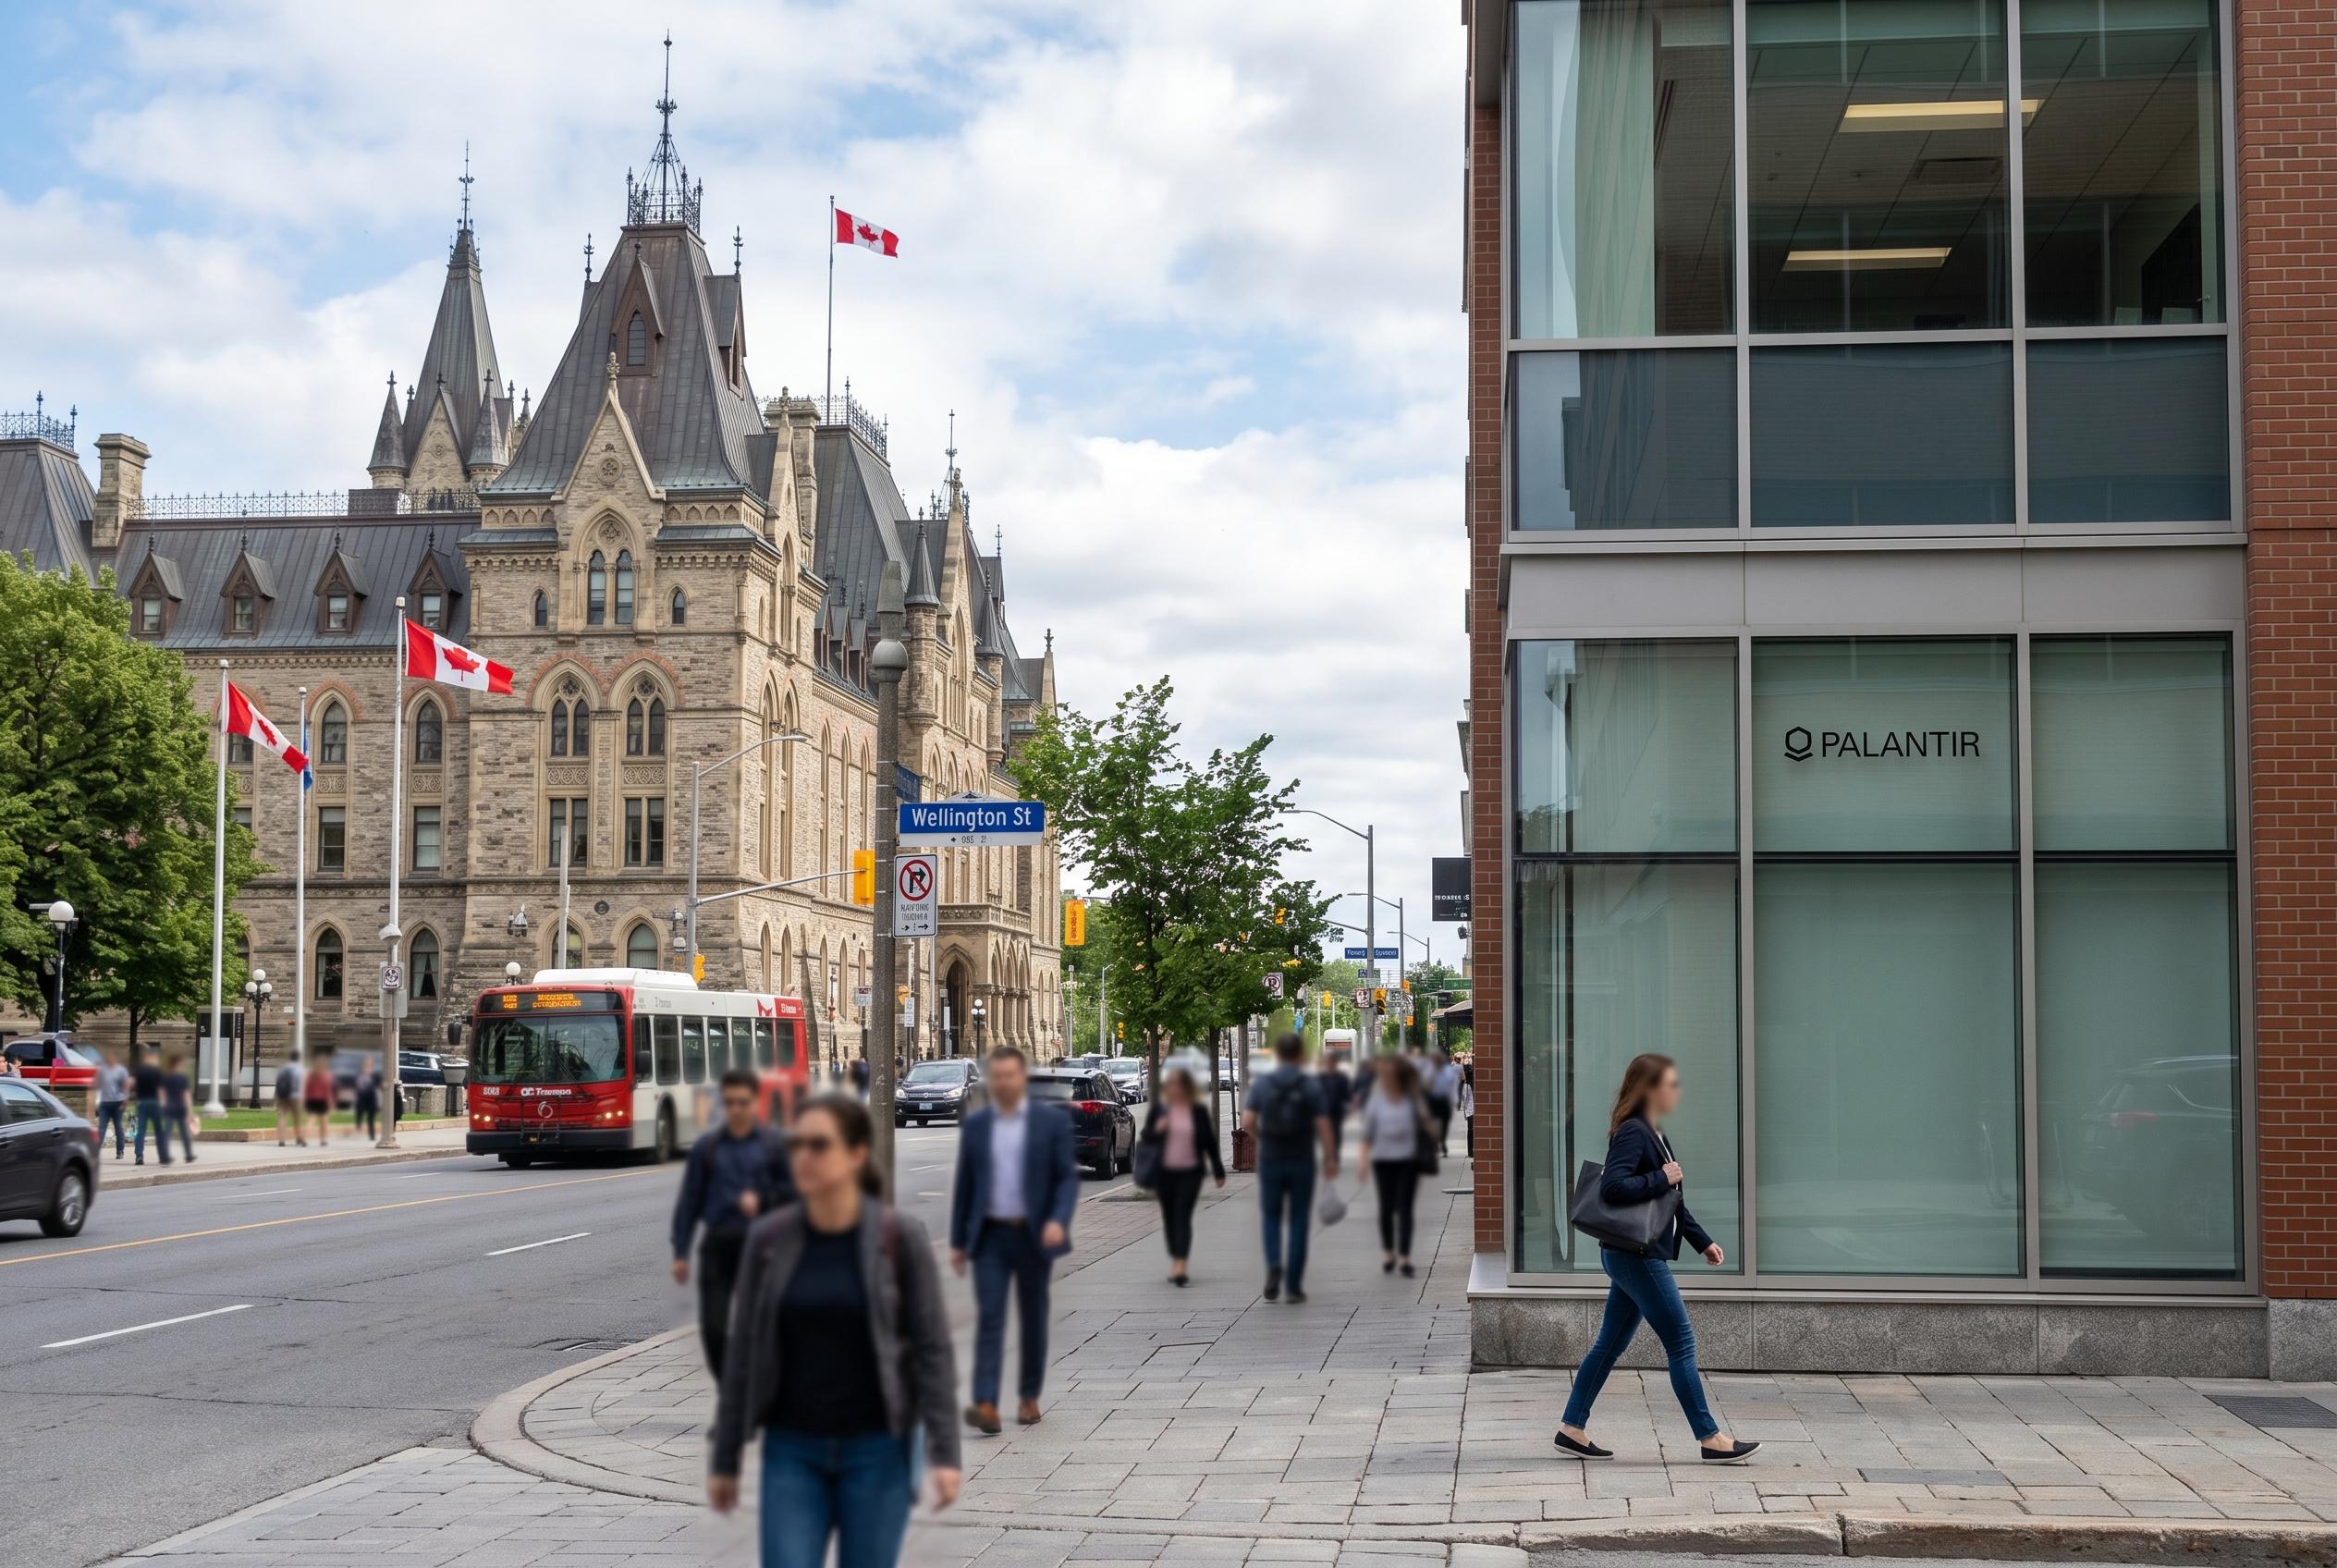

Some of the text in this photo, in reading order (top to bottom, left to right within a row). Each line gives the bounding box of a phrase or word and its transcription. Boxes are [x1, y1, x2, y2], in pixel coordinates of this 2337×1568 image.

[1822, 731, 1980, 757] PALANTIR
[912, 807, 1032, 832] Wellington St
